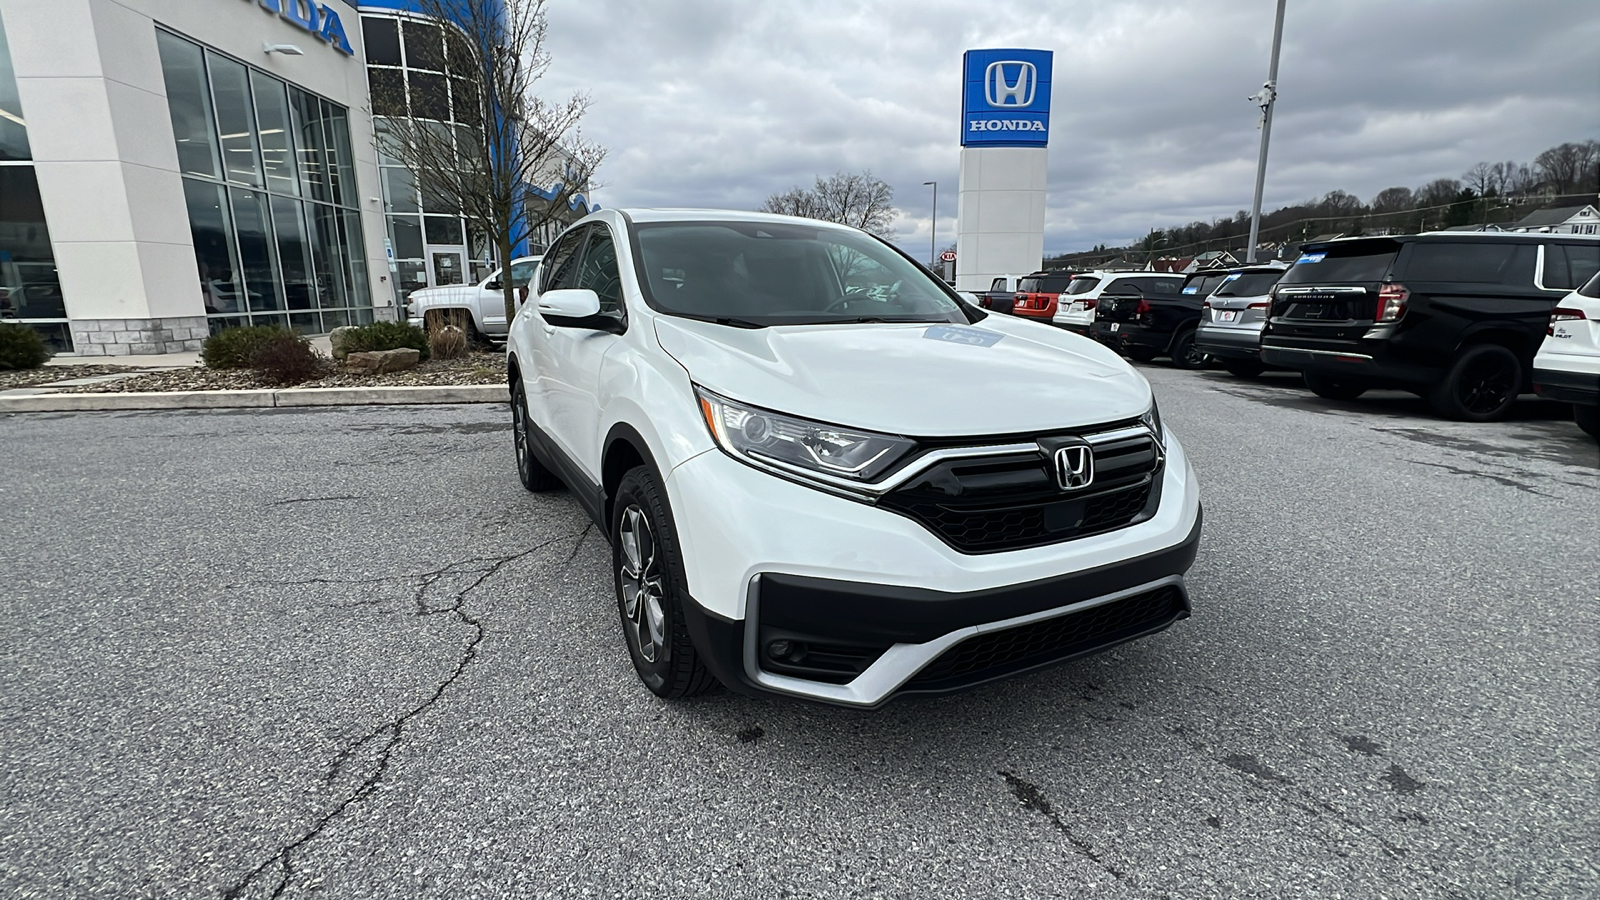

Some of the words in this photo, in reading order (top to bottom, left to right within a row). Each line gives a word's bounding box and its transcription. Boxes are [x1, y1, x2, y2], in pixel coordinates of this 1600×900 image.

[259, 0, 354, 56] DA
[969, 120, 1046, 131] HONDA
[943, 252, 956, 260] KIA
